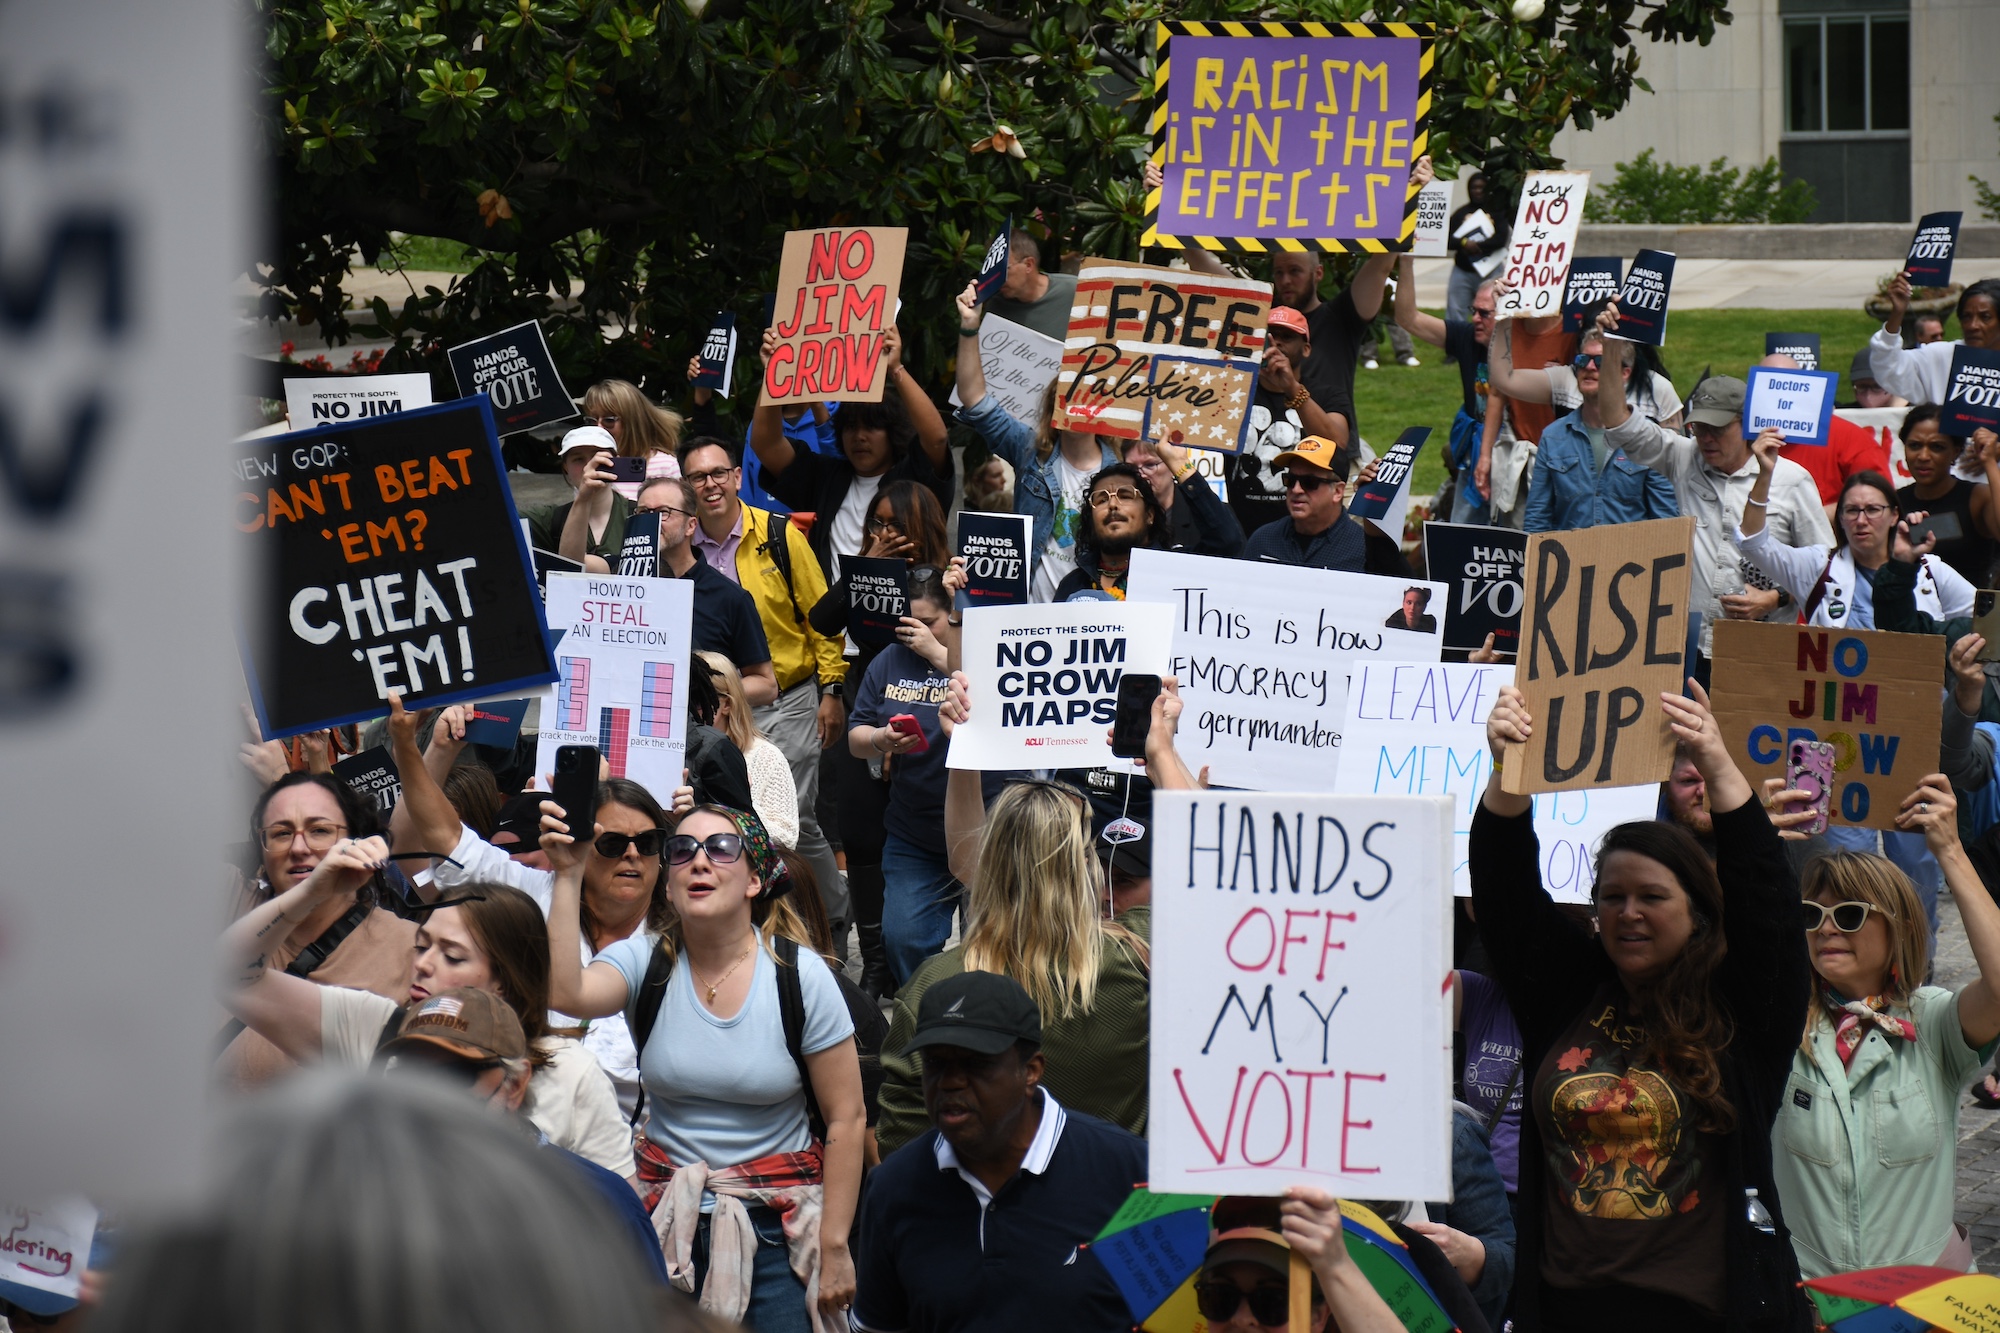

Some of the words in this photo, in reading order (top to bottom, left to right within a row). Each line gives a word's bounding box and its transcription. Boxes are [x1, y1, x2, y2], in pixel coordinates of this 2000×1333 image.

[1527, 180, 1573, 207] say
[1417, 212, 1445, 220] ROW
[1430, 202, 1447, 210] JIM
[1525, 199, 1568, 225] NO
[1530, 225, 1549, 239] to
[1915, 235, 1931, 243] OFF
[1931, 234, 1952, 242] OUR
[1920, 226, 1950, 234] HANDS
[806, 229, 874, 284] NO
[1511, 242, 1566, 265] JIM
[1908, 242, 1953, 259] VOTE
[1507, 264, 1570, 288] CROW
[1569, 280, 1591, 288] OFF
[1573, 272, 1612, 280] HANDS
[1627, 276, 1643, 285] OFF
[1643, 279, 1665, 291] OUR
[1632, 267, 1663, 281] HANDS
[1505, 289, 1550, 310] 2.0
[1620, 284, 1666, 311] VOTE
[777, 283, 887, 339] JIM
[1105, 284, 1261, 357] FREE
[714, 336, 728, 344] OUR
[981, 330, 1018, 354] Of
[1012, 342, 1038, 362] the
[1775, 346, 1812, 354] HANDS
[473, 345, 519, 370] HANDS
[765, 332, 885, 399] CROW
[473, 366, 498, 384] OFF
[500, 356, 529, 376] OUR
[1004, 369, 1029, 388] the
[1065, 343, 1220, 407] Palestine
[1956, 374, 1982, 384] OFF
[368, 390, 399, 398] SOUTH:
[1768, 378, 1811, 393] Doctors
[312, 401, 350, 419] NO
[358, 400, 403, 418] JIM
[1777, 398, 1794, 410] for
[1754, 416, 1814, 433] Democracy
[292, 442, 350, 470] GOP:
[1395, 454, 1412, 464] OUR
[374, 448, 473, 504] BEAT
[624, 535, 650, 547] HANDS
[963, 545, 988, 555] OFF
[990, 547, 1018, 558] OUR
[968, 535, 1013, 548] HANDS
[620, 548, 634, 558] OFF
[634, 546, 653, 556] OUR
[962, 555, 1022, 580] VOTE
[1464, 562, 1512, 578] OFF
[589, 582, 622, 598] HOW
[626, 584, 645, 599] TO
[849, 582, 872, 592] OFF
[875, 586, 902, 596] OUR
[852, 574, 896, 586] HANDS
[288, 556, 477, 646] CHEAT
[850, 590, 906, 616] VOTE
[1528, 538, 1686, 681] RISE
[582, 600, 650, 627] STEAL
[1172, 588, 1251, 640] This
[1274, 612, 1298, 645] is
[1316, 608, 1382, 652] how
[572, 624, 591, 638] AN
[602, 628, 667, 646] ELECTION
[1000, 627, 1052, 637] PROTECT
[1055, 626, 1078, 634] THE
[1080, 624, 1125, 634] SOUTH:
[996, 640, 1053, 668] NO
[1063, 638, 1127, 666] JIM
[1796, 631, 1869, 678] NO
[997, 668, 1123, 698] CROW
[1168, 655, 1327, 707] EMOCRACY
[1358, 666, 1494, 724] LEAVE
[1788, 680, 1879, 725] JIM
[484, 712, 510, 723] Tennessee
[1002, 698, 1118, 728] MAPS
[540, 731, 562, 740] crack
[564, 732, 578, 742] the
[580, 734, 598, 743] vote
[630, 738, 650, 748] pack
[652, 739, 666, 748] the
[667, 741, 685, 750] vote
[1024, 738, 1044, 746] ACLU
[1045, 736, 1088, 746] Tennessee
[1544, 686, 1644, 783] UP
[346, 766, 387, 787] HANDS
[371, 774, 396, 789] OUR
[1187, 801, 1396, 901] HANDS
[1226, 907, 1356, 981] OFF
[1201, 984, 1349, 1065] MY
[1477, 1085, 1504, 1098] YOU
[1173, 1066, 1386, 1173] VOTE
